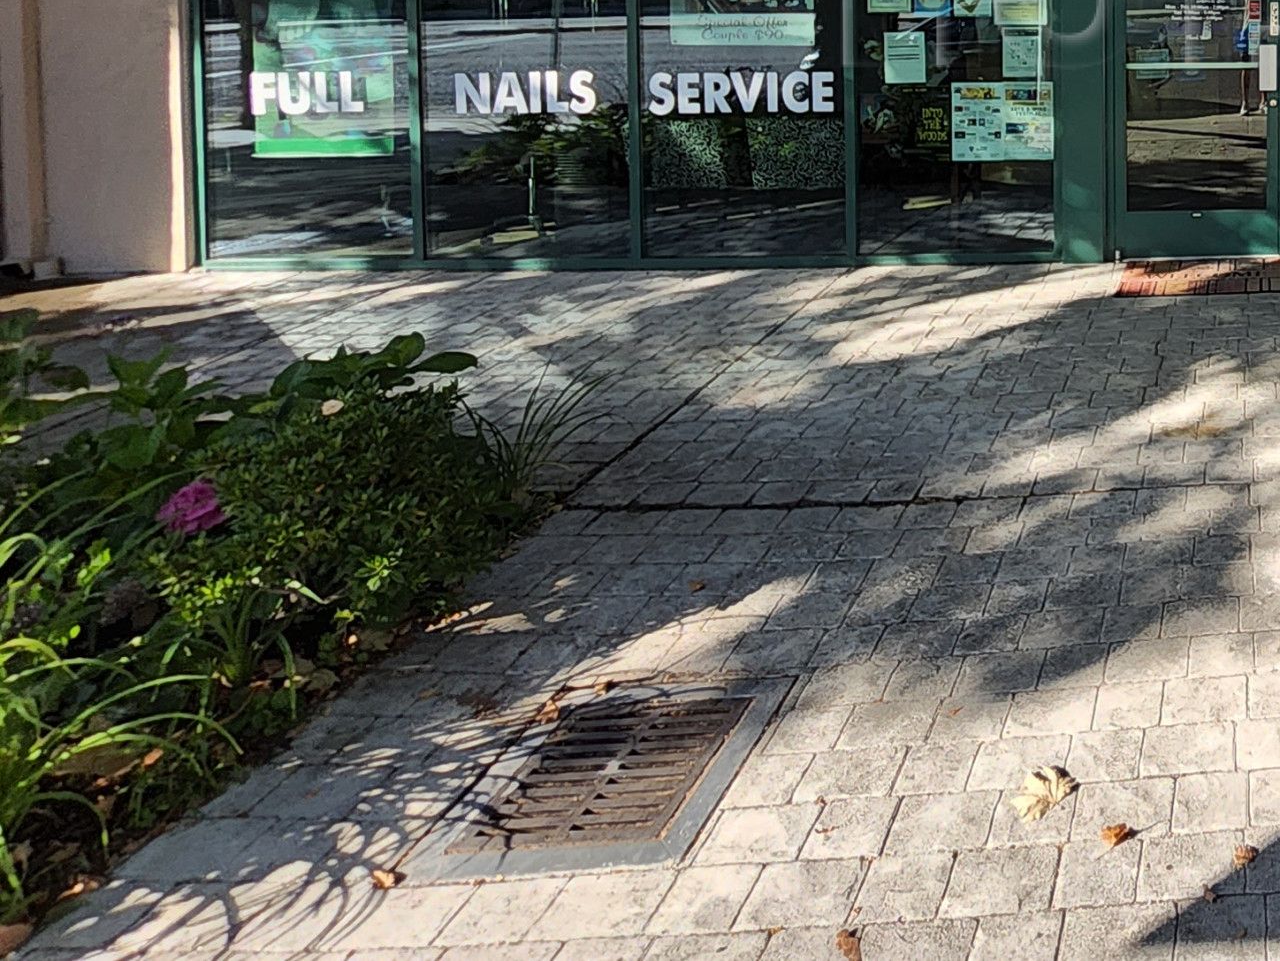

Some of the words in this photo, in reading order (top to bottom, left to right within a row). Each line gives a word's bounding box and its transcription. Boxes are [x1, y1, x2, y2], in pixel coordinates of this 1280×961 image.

[250, 70, 365, 116] FULL
[453, 70, 597, 116] NAILS
[649, 70, 835, 117] SERVICE
